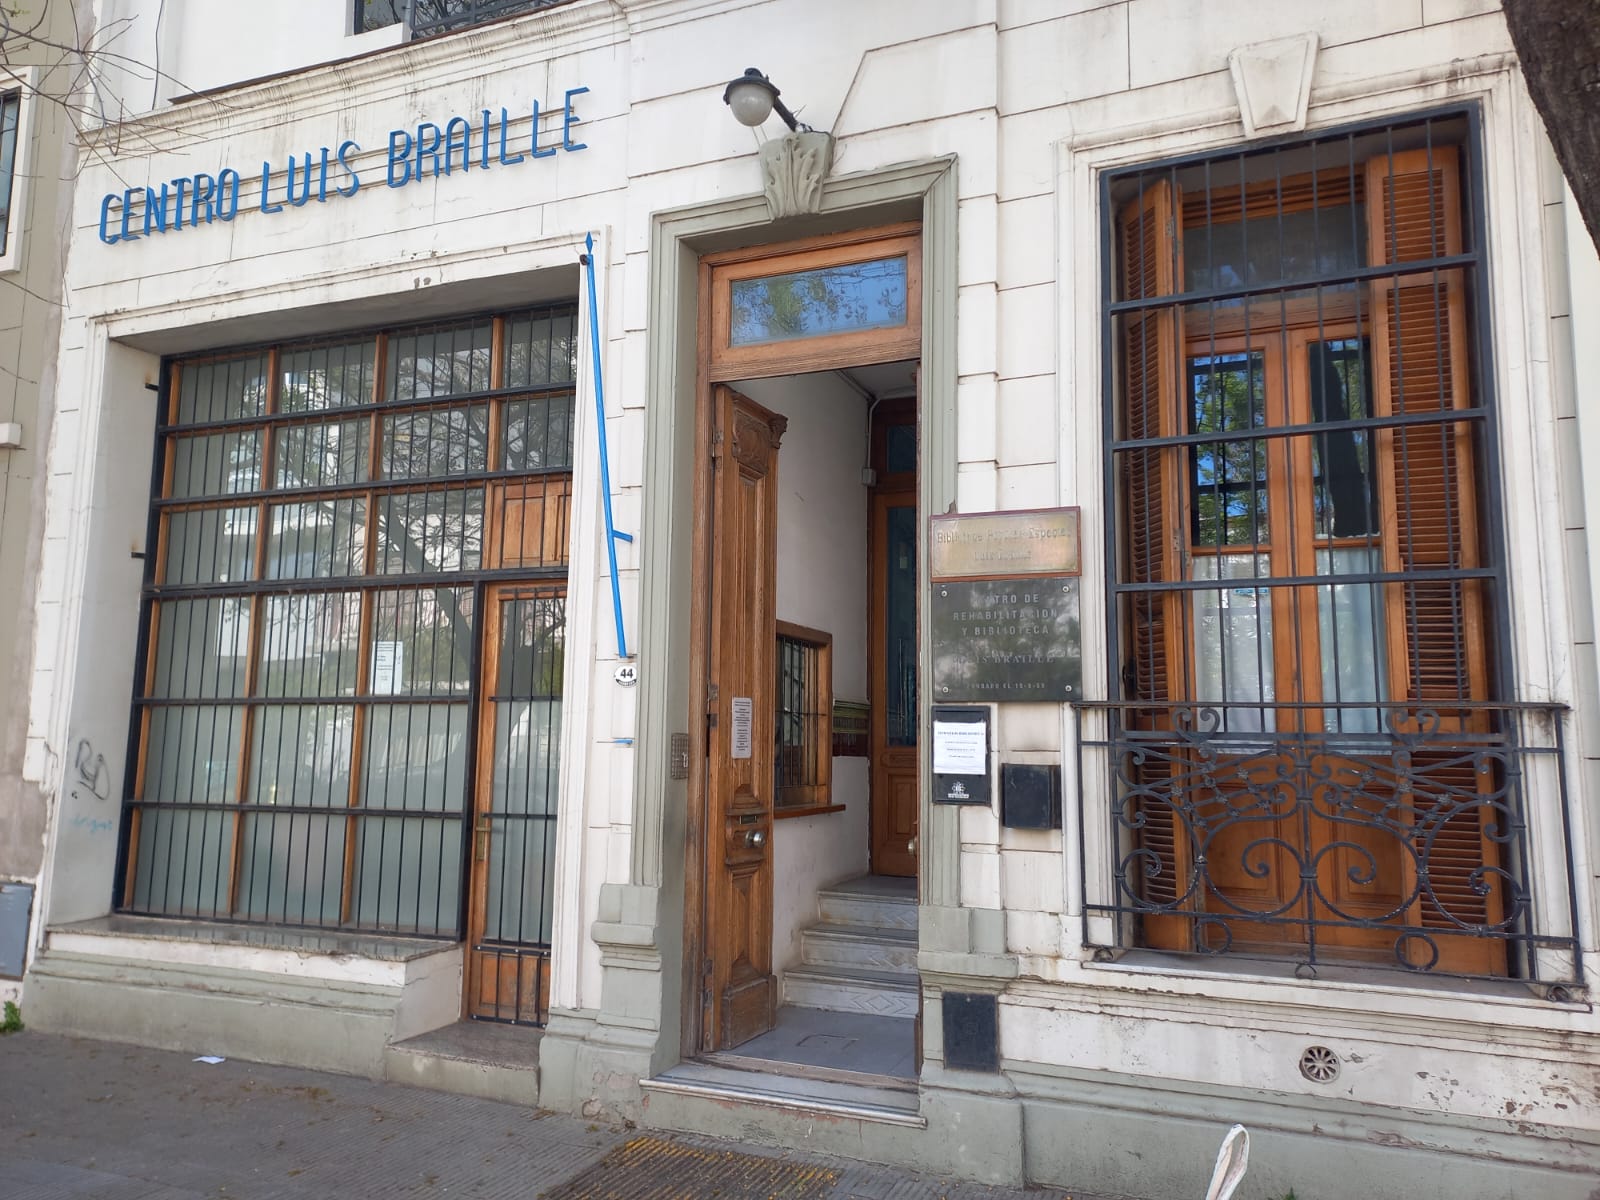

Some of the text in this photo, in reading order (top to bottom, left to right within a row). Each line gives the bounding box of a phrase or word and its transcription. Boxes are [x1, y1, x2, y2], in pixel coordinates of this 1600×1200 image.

[100, 87, 590, 245] CENTRO LUIS BRAILLE
[1024, 593, 1040, 603] DE
[961, 627, 968, 636] Y
[620, 668, 634, 679] 44
